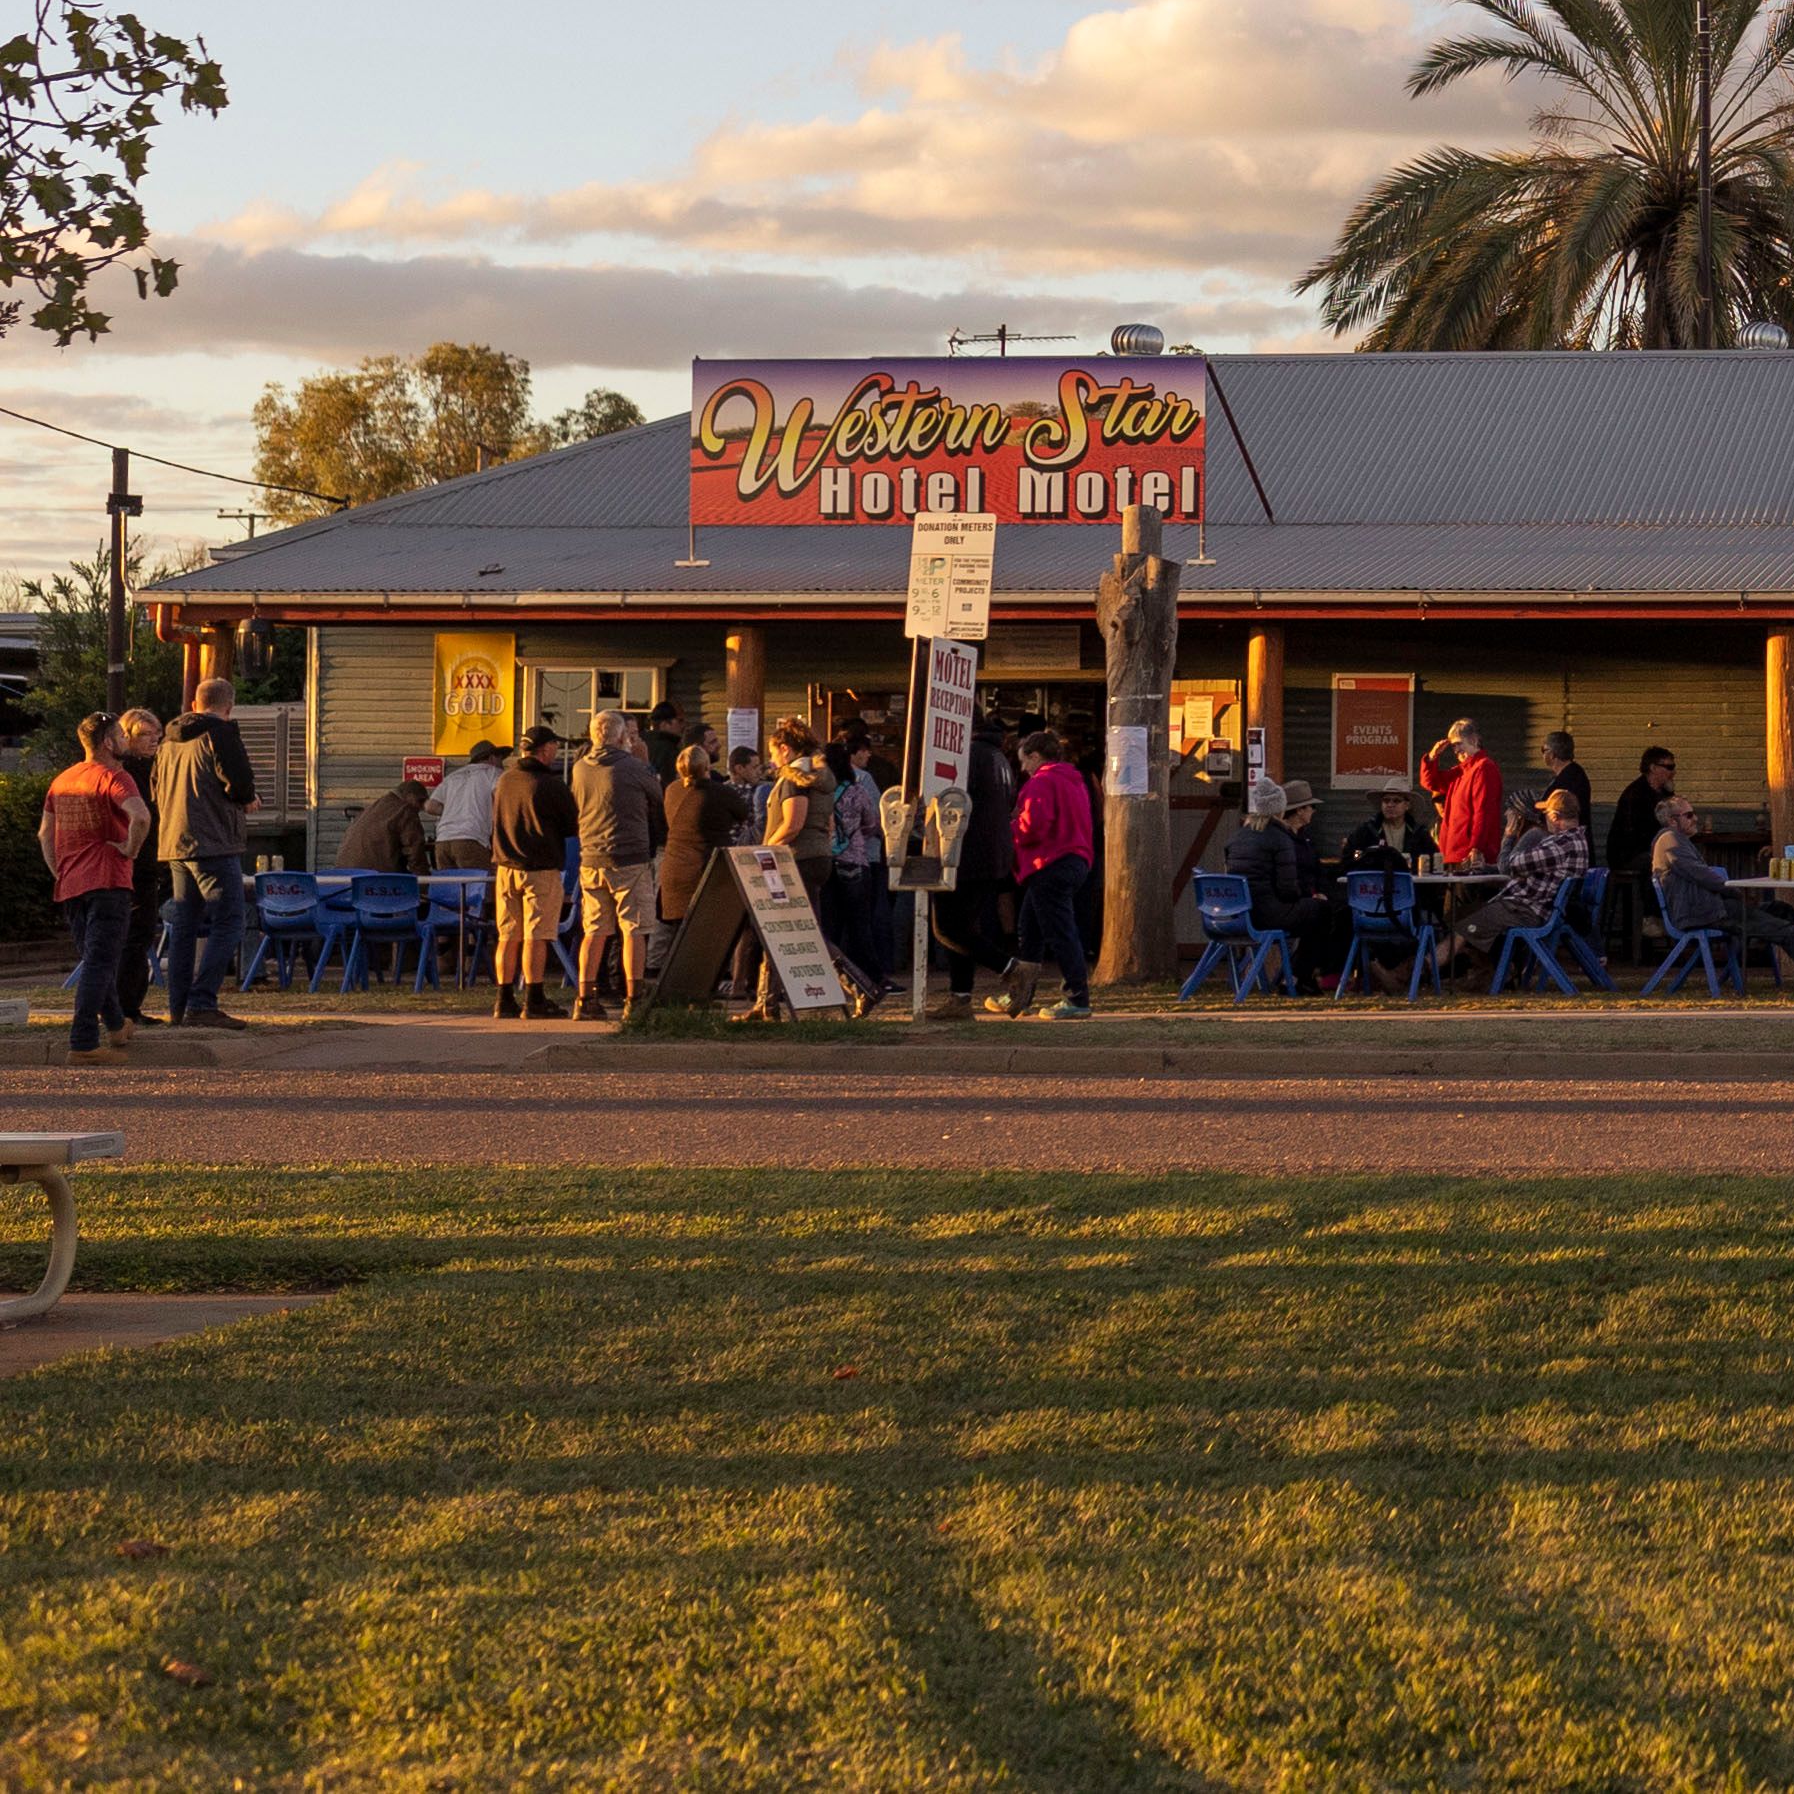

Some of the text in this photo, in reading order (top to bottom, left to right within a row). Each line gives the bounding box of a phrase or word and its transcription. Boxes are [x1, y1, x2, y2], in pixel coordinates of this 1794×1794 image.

[700, 369, 1200, 501] Western Star
[818, 466, 1197, 515] Hotel Motel
[918, 523, 993, 532] DONATION METERS
[944, 536, 965, 545] ONLY
[933, 649, 973, 690] MOTEL
[455, 674, 496, 689] XXXX
[444, 693, 505, 716] GOLD
[930, 687, 973, 719] RECEPTION
[933, 716, 965, 755] HERE
[1353, 725, 1392, 735] EVENTS
[1345, 735, 1399, 745] PROGRAM
[406, 764, 441, 774] SMOKING
[413, 774, 434, 783] AREA
